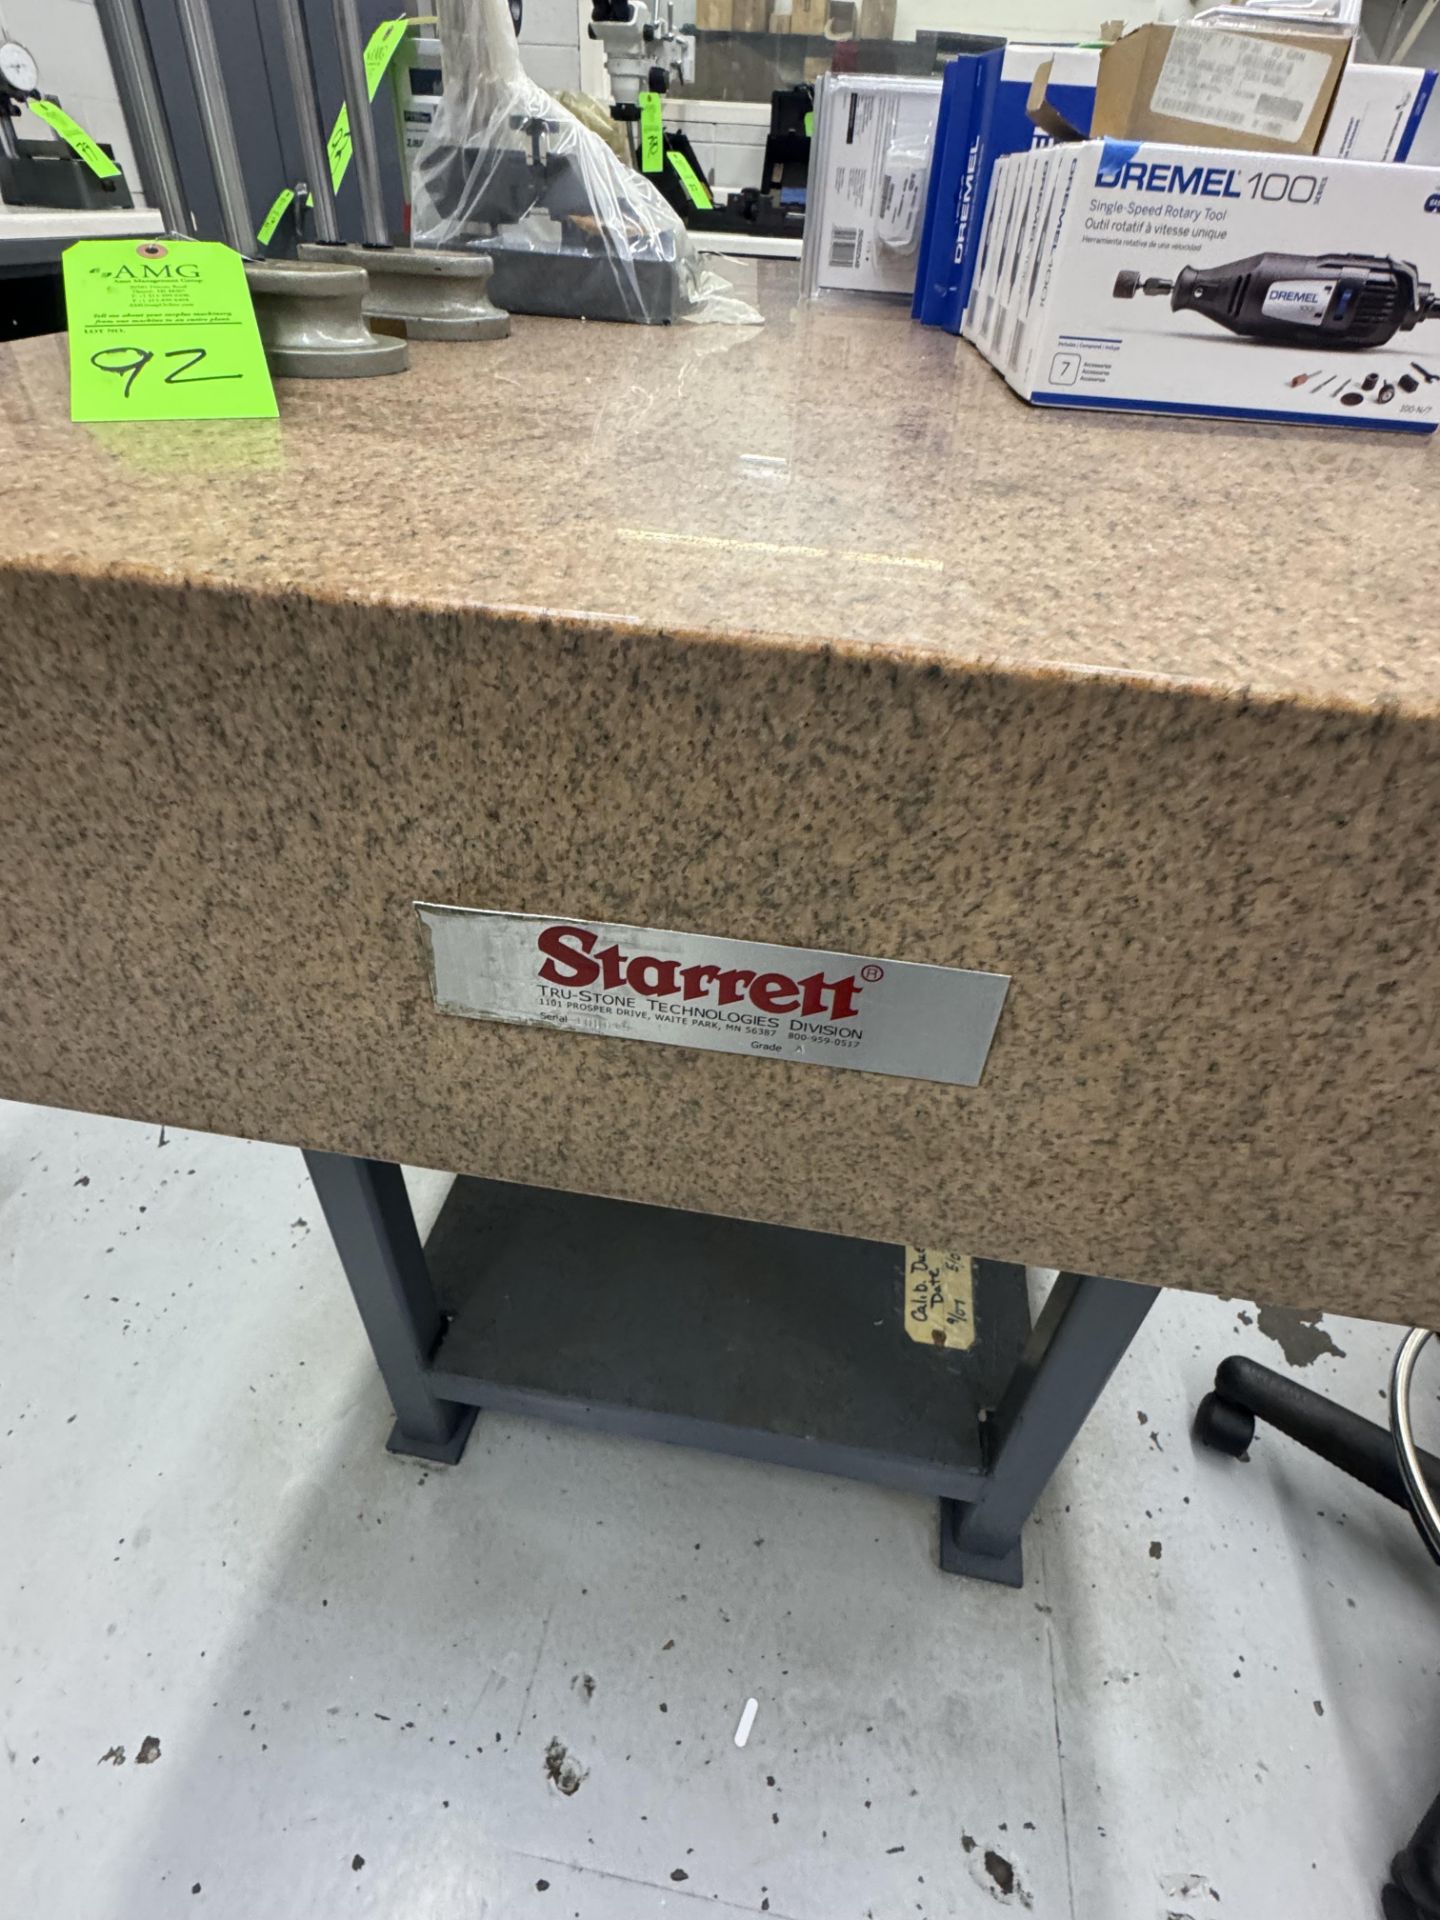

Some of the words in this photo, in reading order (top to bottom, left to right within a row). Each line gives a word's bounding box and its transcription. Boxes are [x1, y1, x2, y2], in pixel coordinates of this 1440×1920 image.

[1094, 162, 1241, 198] DREMEL
[1248, 172, 1317, 203] 100
[954, 135, 980, 264] DREMEL
[1089, 199, 1163, 218] Single-Speed
[1165, 206, 1202, 222] Rotary
[1204, 208, 1227, 221] Tool
[1085, 217, 1110, 230] Outil
[1111, 219, 1144, 233] rotatif
[1145, 223, 1152, 234] à
[1154, 224, 1190, 237] vitesse
[1191, 228, 1228, 240] unique
[113, 264, 201, 278] AMG
[1269, 290, 1318, 303] DREMEL
[91, 347, 243, 398] 92
[1060, 361, 1071, 376] 7
[538, 925, 863, 1020] Starrett
[537, 985, 636, 1008] TRU-STONE
[646, 998, 780, 1029] TECHNOLOGIES
[790, 1019, 863, 1040] DIVISION
[539, 998, 562, 1009] 1101
[566, 1001, 612, 1014] PROSPER
[616, 1007, 650, 1021] DRIVE,
[654, 1014, 688, 1026] WAITE
[692, 1018, 721, 1031] PARK,
[726, 1024, 741, 1033] MN
[745, 1026, 777, 1037] 56387
[788, 1032, 860, 1049] 800-959-0517
[540, 1011, 567, 1023] Serial
[751, 1041, 783, 1053] Grade
[927, 1268, 945, 1309] Date
